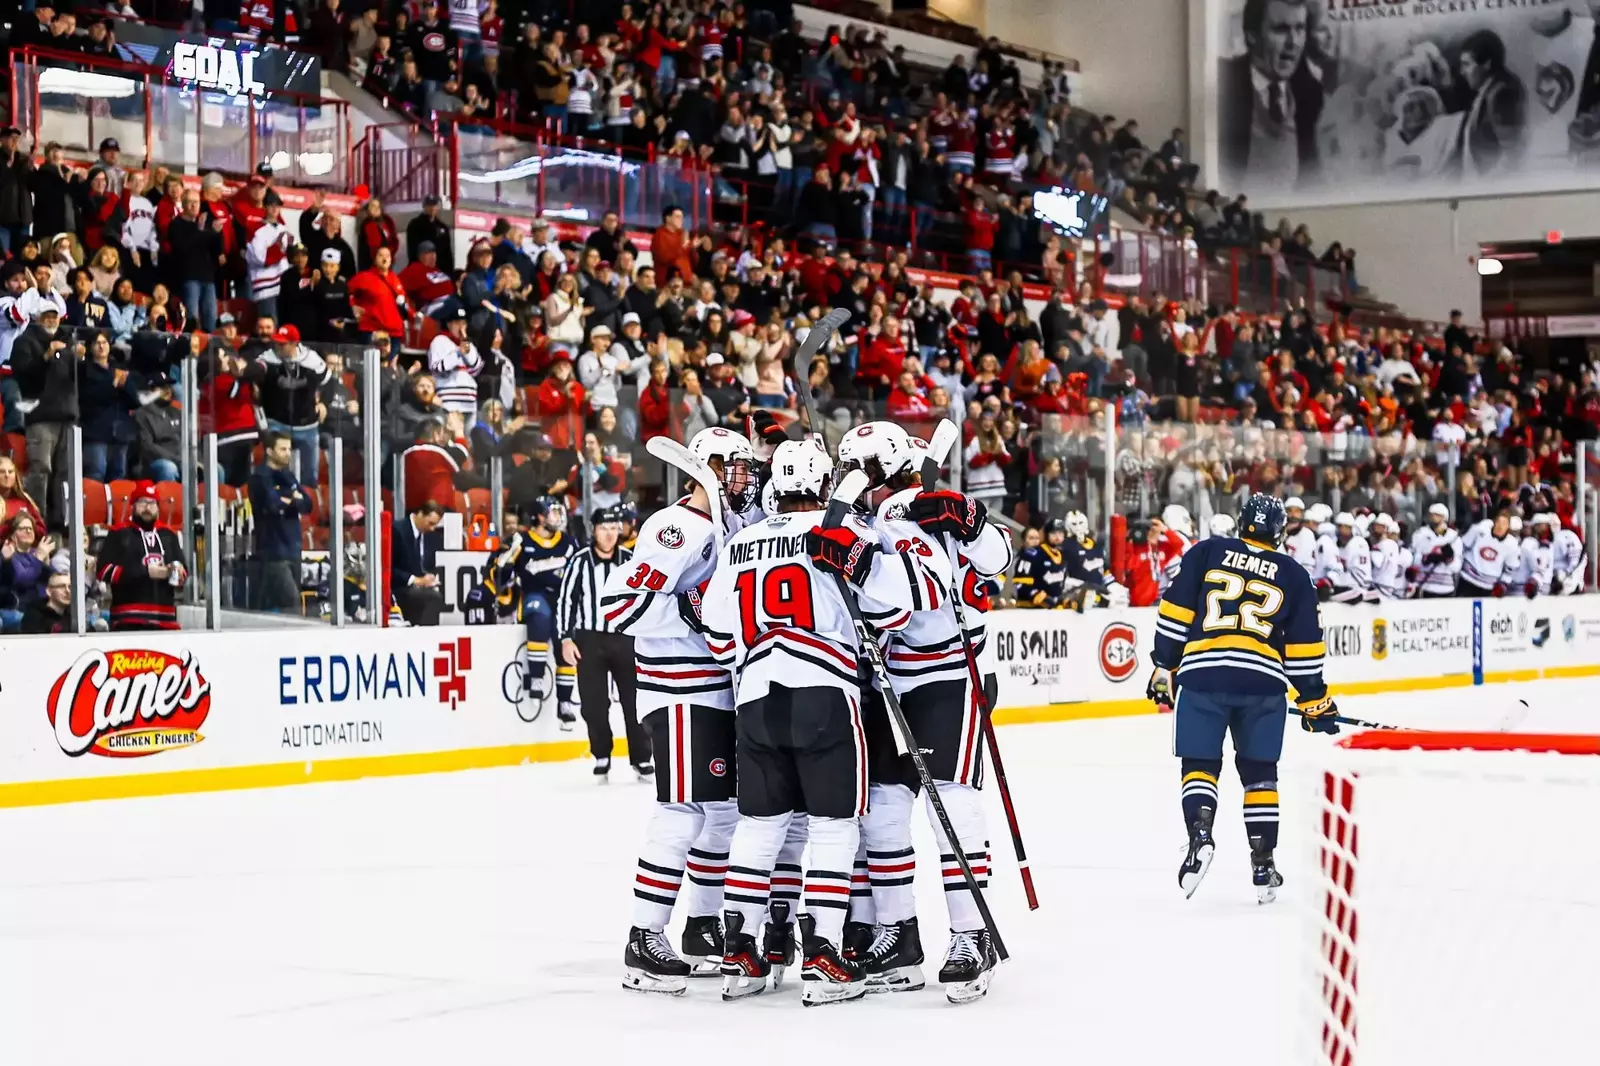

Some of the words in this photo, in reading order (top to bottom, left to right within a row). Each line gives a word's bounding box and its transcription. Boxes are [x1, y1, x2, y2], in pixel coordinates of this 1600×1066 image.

[173, 42, 266, 96] GOAL
[783, 465, 794, 476] 19
[1254, 512, 1267, 524] 22
[1221, 550, 1279, 580] ZIEMER
[733, 562, 815, 651] 19
[1202, 568, 1285, 639] 22
[1393, 617, 1450, 634] NEWPORT
[997, 631, 1014, 661] GO
[1392, 636, 1470, 653] HEALTHCARE
[110, 653, 166, 675] Raising
[279, 651, 426, 705] ERDMAN
[54, 648, 211, 757] Cane's
[109, 736, 151, 748] CHICKEN
[154, 731, 196, 745] FINGERS
[281, 720, 383, 748] AUTOMATION
[909, 746, 946, 820] JETSPEED
